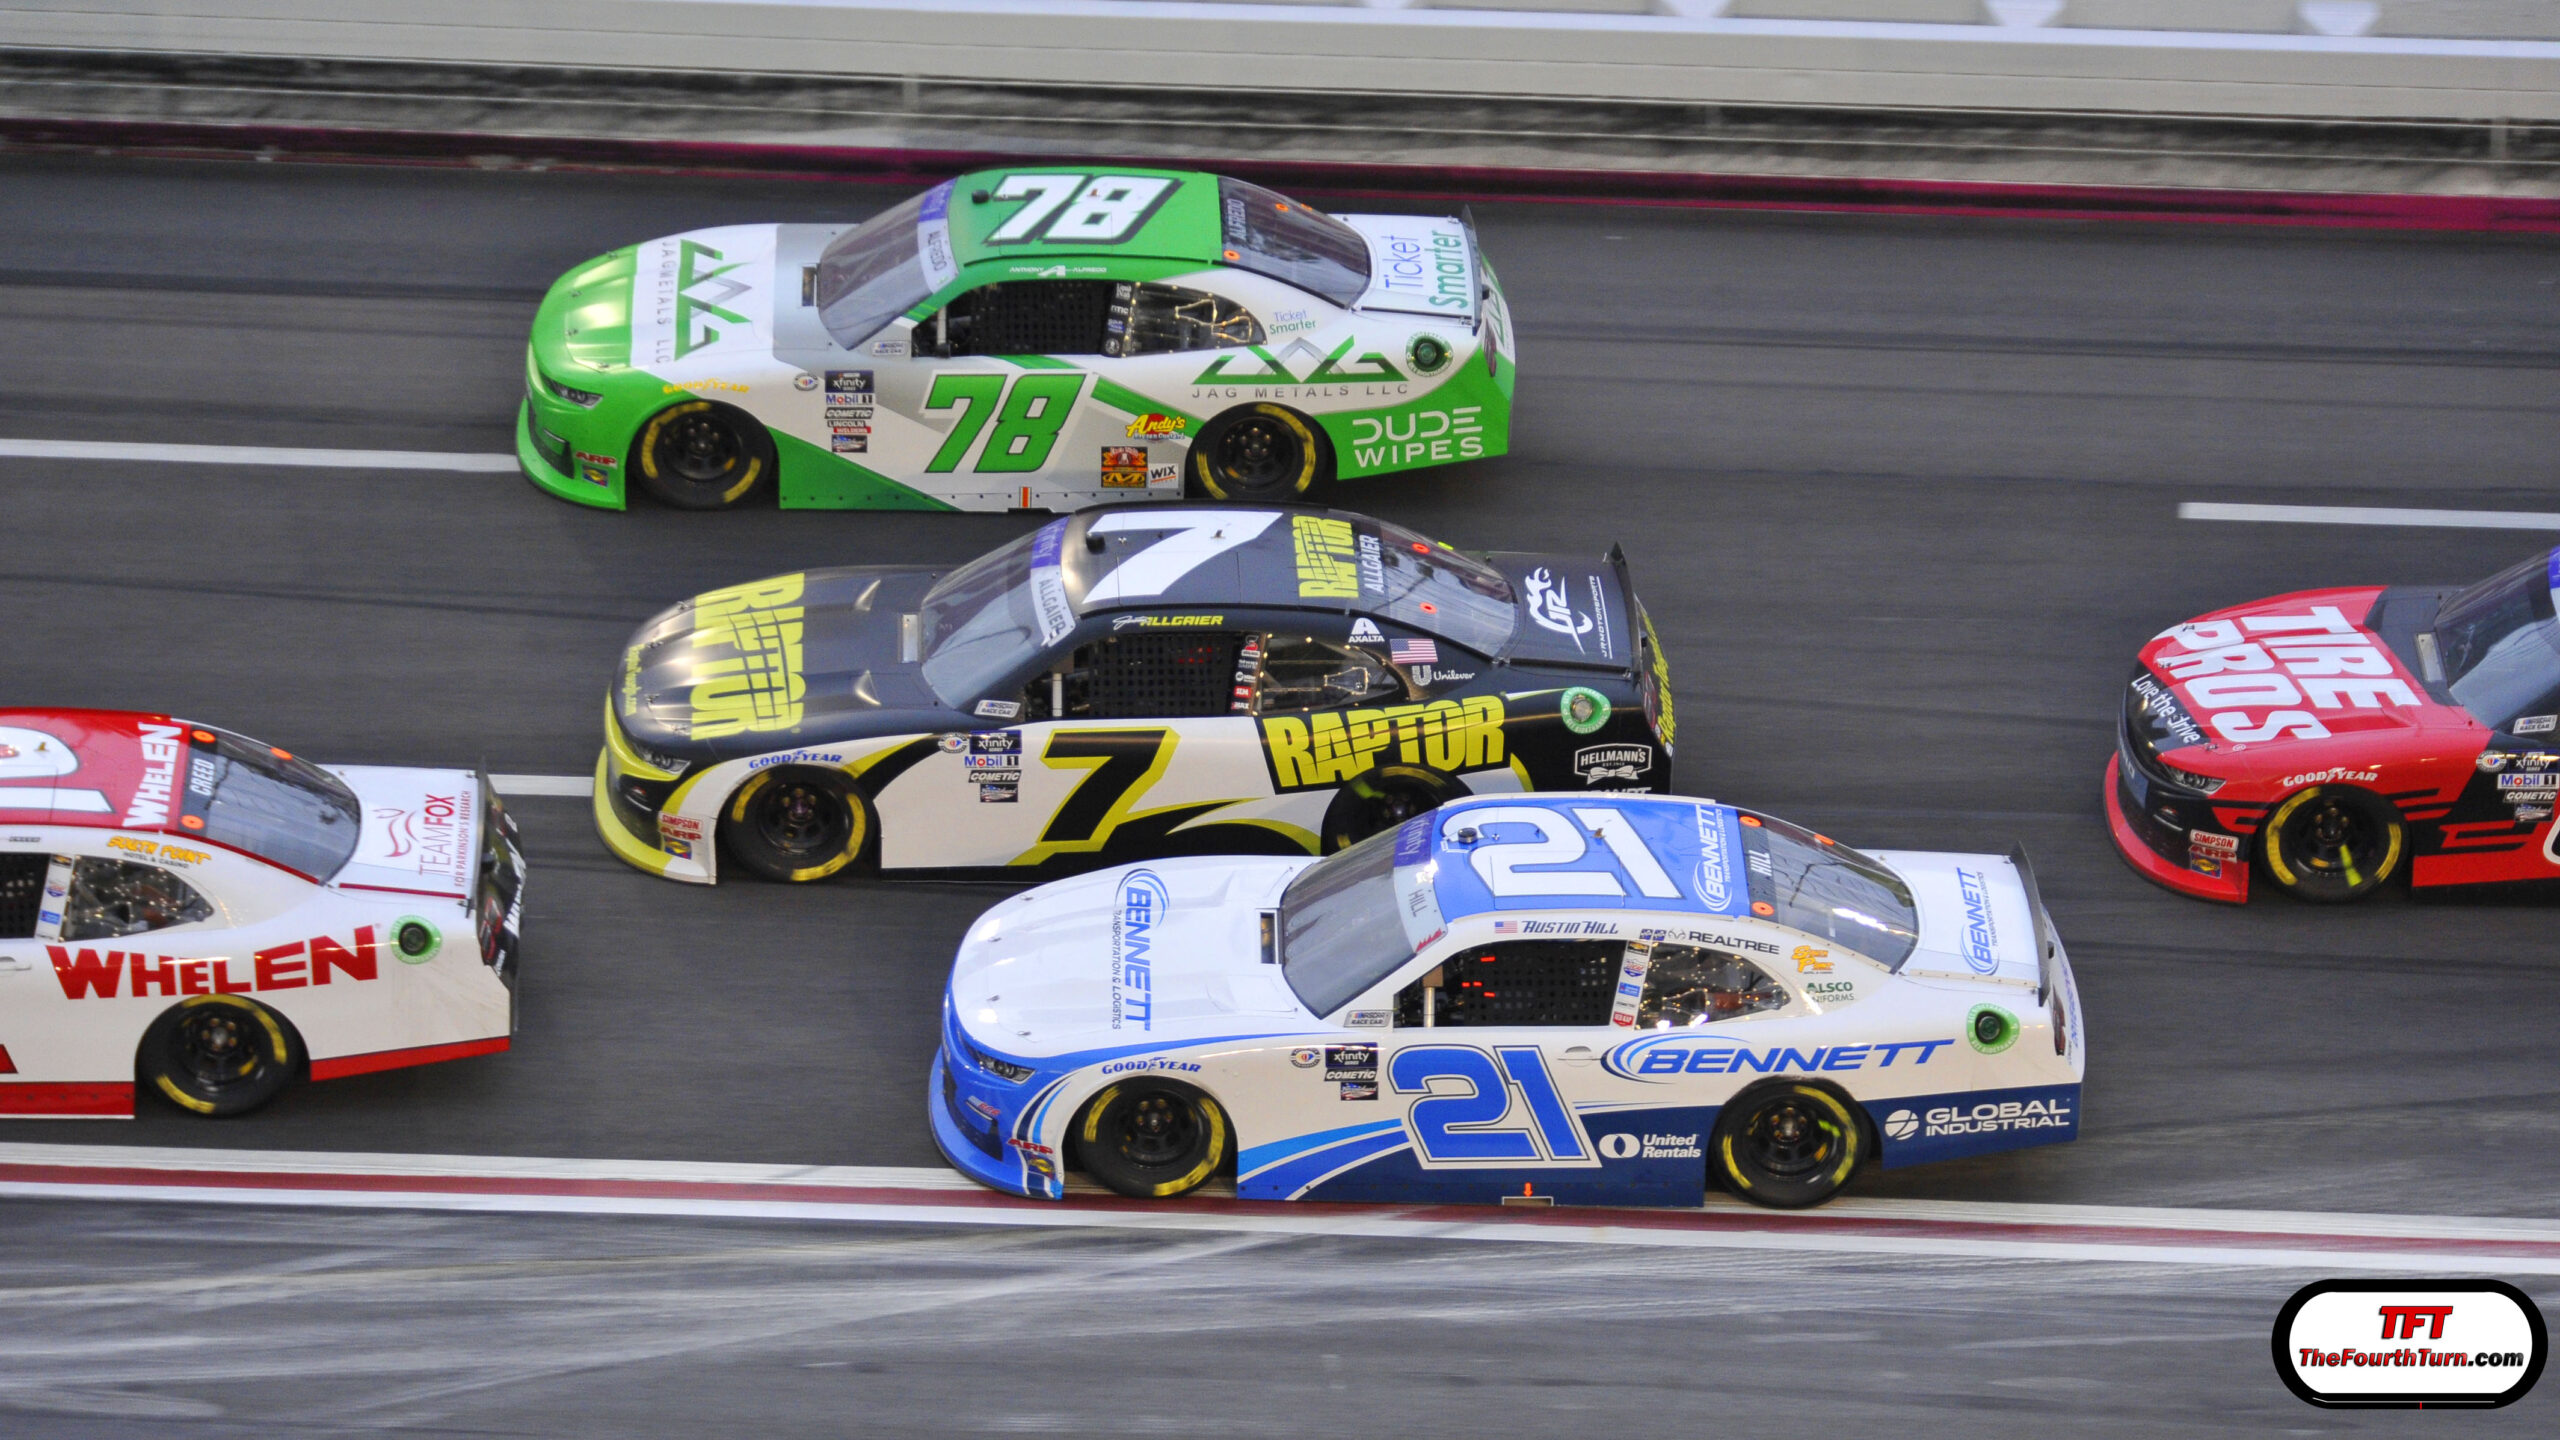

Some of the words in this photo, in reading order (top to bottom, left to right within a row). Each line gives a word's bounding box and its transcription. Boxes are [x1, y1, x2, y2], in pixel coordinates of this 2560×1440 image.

[984, 173, 1180, 244] 78
[1227, 199, 1246, 240] ALFREDO
[1381, 235, 1423, 288] Ticket
[1424, 230, 1468, 308] Smarter
[1270, 318, 1317, 335] Smarter
[1273, 308, 1308, 322] Ticket
[826, 394, 858, 404] Mobil
[1192, 386, 1237, 398] JAG
[1255, 385, 1349, 398] METALS
[1366, 384, 1408, 395] LLC
[826, 409, 872, 417] COMETIC
[924, 374, 1087, 473] 78
[1126, 413, 1186, 438] Andy's
[1353, 406, 1482, 445] DUDE
[1354, 437, 1483, 468] WIPES
[1150, 466, 1176, 479] WIX
[1082, 510, 1283, 604] 7
[1292, 515, 1359, 598] RAPTOR
[1359, 534, 1384, 594] ALLGAIER
[1038, 578, 1068, 634] ALLGAIER
[1140, 615, 1224, 626] ALLGAIER
[690, 573, 806, 740] RAPTOR
[2241, 606, 2423, 708] TIRE
[1433, 670, 1475, 681] Unilever
[2151, 619, 2332, 742] PROS
[2131, 673, 2159, 699] Love
[2150, 692, 2176, 718] the
[978, 738, 1013, 749] xfinity
[1263, 695, 1505, 788] RAPTOR
[749, 750, 842, 770] GOODYEAR
[964, 756, 1002, 766] Mobil
[1580, 748, 1646, 766] HELLMANN'S
[2516, 757, 2550, 770] xfinity
[122, 722, 182, 828] WHELEN
[189, 757, 216, 796] CREED
[970, 772, 1020, 780] COMETIC
[1038, 728, 1170, 844] 7
[2283, 768, 2378, 787] GOODYEAR
[2501, 775, 2539, 785] Mobil
[460, 791, 472, 820] RESEARCH
[2506, 792, 2556, 800] COMETIC
[661, 828, 702, 840] ARP
[662, 814, 700, 829] SIMPSON
[107, 836, 159, 854] SOUTH
[160, 845, 212, 864] POINT
[456, 821, 470, 869] PARKINSON'S
[1442, 806, 1686, 898] 21
[1696, 804, 1725, 898] BENNETT
[2190, 845, 2236, 858] ARP
[2194, 833, 2234, 848] SIMPSON
[1749, 850, 1772, 876] HILL
[454, 870, 465, 887] FOR
[1408, 889, 1428, 918] HILL
[1956, 867, 1993, 965] BENNETT
[1521, 920, 1584, 934] AUSTIN
[1584, 920, 1619, 934] HILL
[1112, 910, 1122, 976] TRANSPORTATION
[1689, 931, 1780, 954] REALTREE
[44, 924, 377, 1000] WHELEN
[1125, 886, 1151, 1031] BENNETT
[1806, 981, 1853, 994] ALSCO
[1112, 985, 1122, 1030] LOGISTICS
[1102, 1056, 1201, 1075] GOODYEAR
[1334, 1051, 1369, 1063] xfinity
[1638, 1038, 1955, 1074] BENNETT
[1326, 1070, 1376, 1079] COMETIC
[1388, 1046, 1591, 1162] 21
[1926, 1099, 2070, 1126] GLOBAL
[1926, 1115, 2070, 1136] INDUSTRIAL
[1007, 1138, 1053, 1154] ARP
[1642, 1146, 1701, 1158] Rentals
[1643, 1134, 1698, 1146] United
